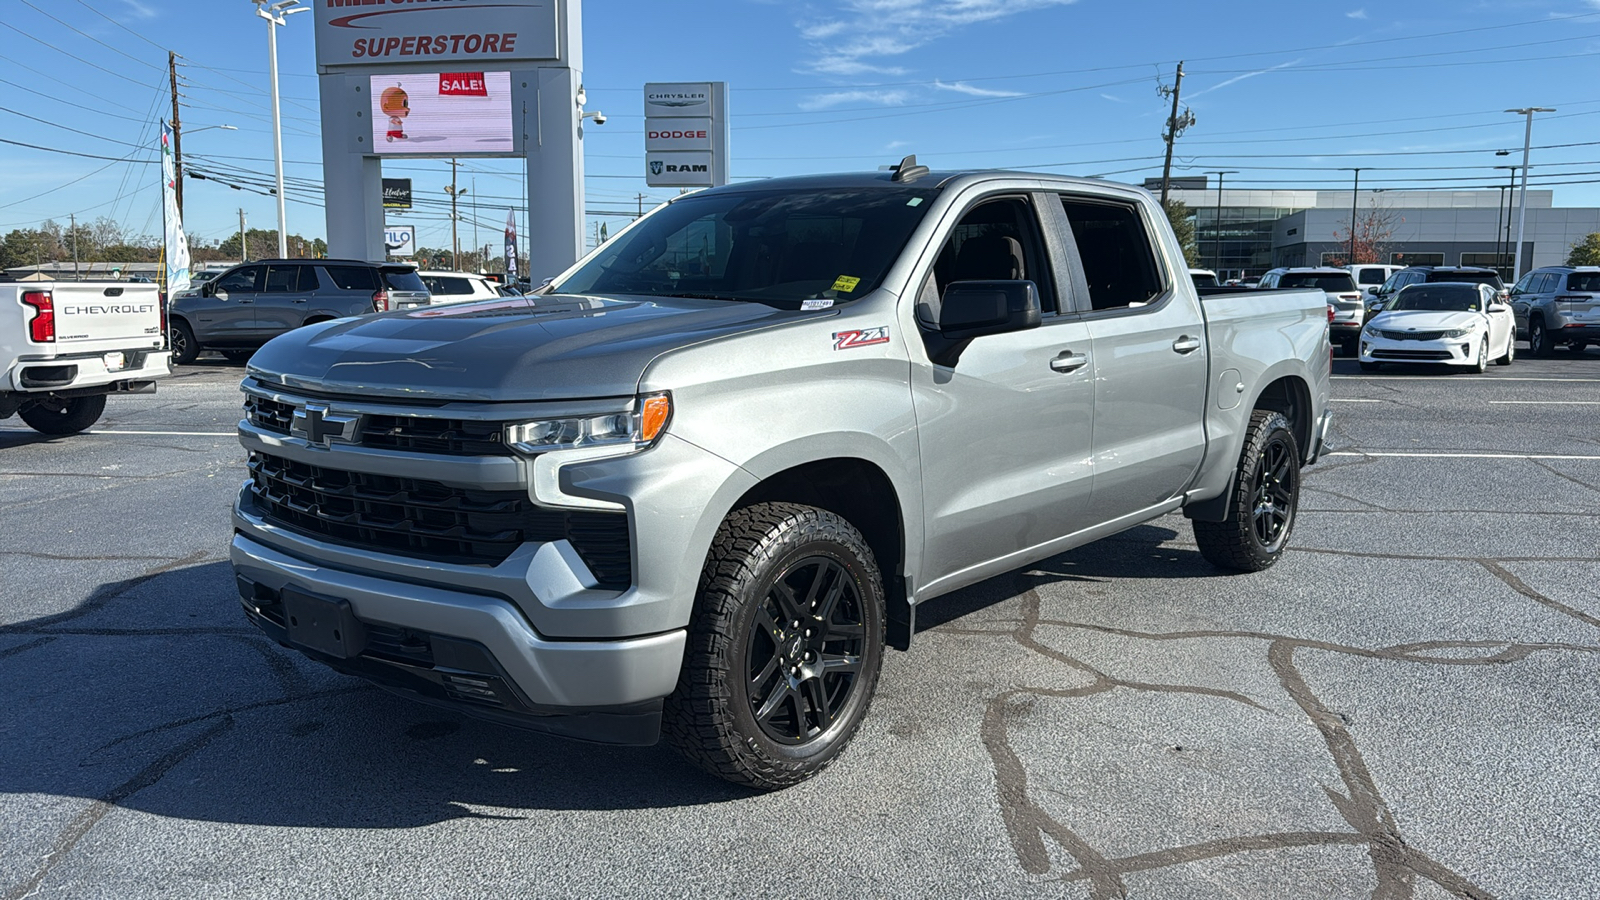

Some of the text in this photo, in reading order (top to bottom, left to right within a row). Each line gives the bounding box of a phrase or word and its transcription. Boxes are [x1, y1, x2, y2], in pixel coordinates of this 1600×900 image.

[352, 33, 517, 58] SUPERSTORE
[441, 80, 483, 91] SALE!
[648, 131, 707, 139] DODGE
[64, 304, 155, 315] CHEVROLET
[832, 326, 890, 351] Z71
